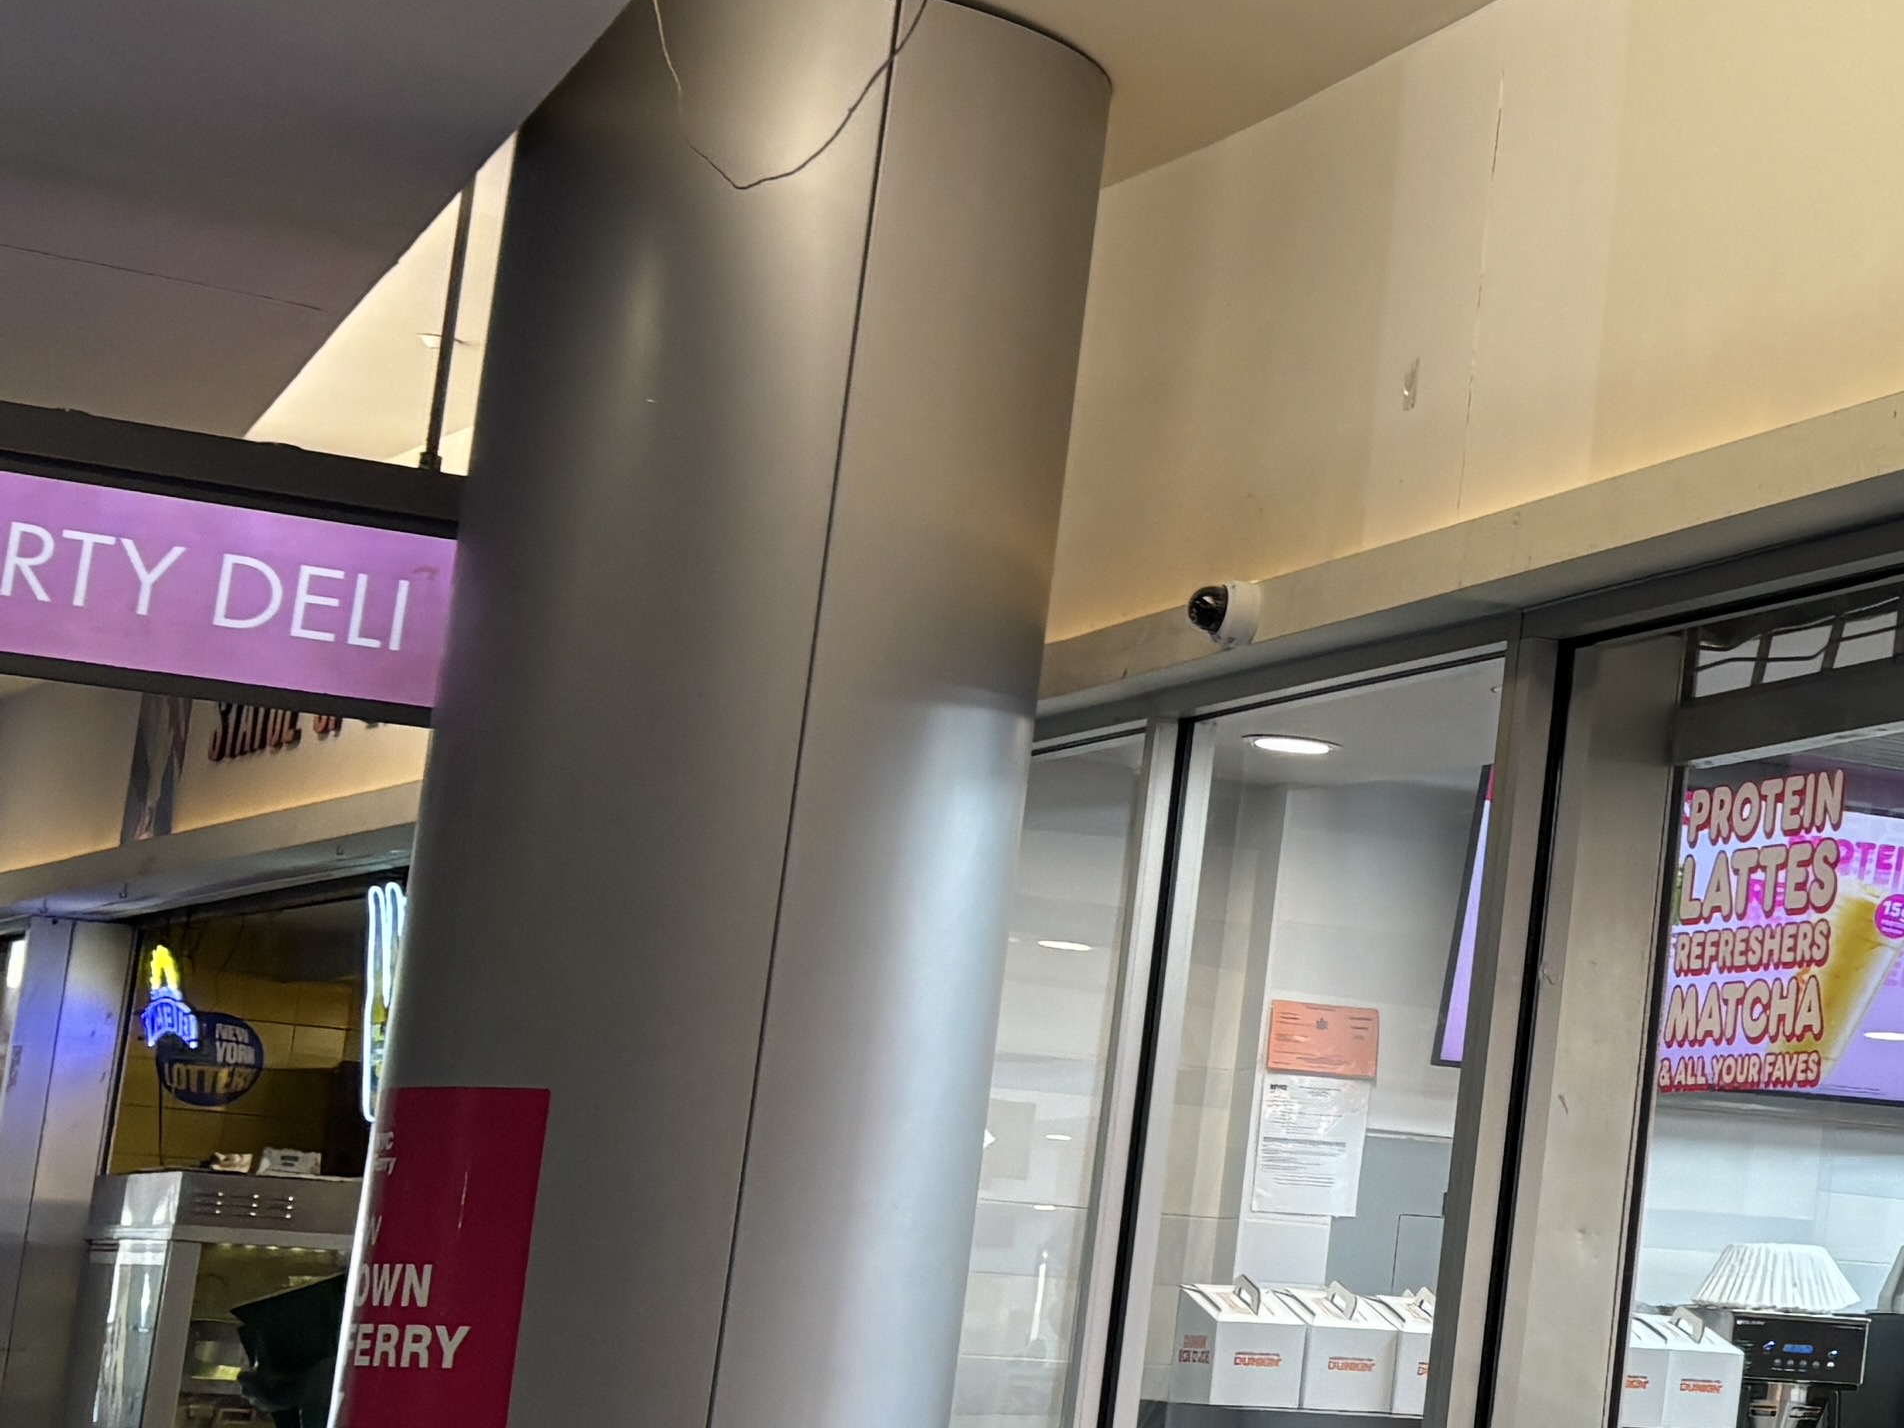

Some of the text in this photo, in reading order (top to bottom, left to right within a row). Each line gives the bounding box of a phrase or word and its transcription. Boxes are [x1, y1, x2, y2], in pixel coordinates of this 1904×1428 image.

[0, 520, 411, 652] RTY DELI
[1687, 769, 1845, 848] PROTEIN
[1678, 838, 1840, 925] LATTES
[1674, 919, 1831, 976] REFRESHERS
[215, 1022, 249, 1044] NEW
[1664, 976, 1823, 1049] MATCHA
[215, 1041, 256, 1065] YORK
[1659, 1050, 1821, 1092] & ALL YOUR FAVES
[353, 1263, 433, 1309] OWN
